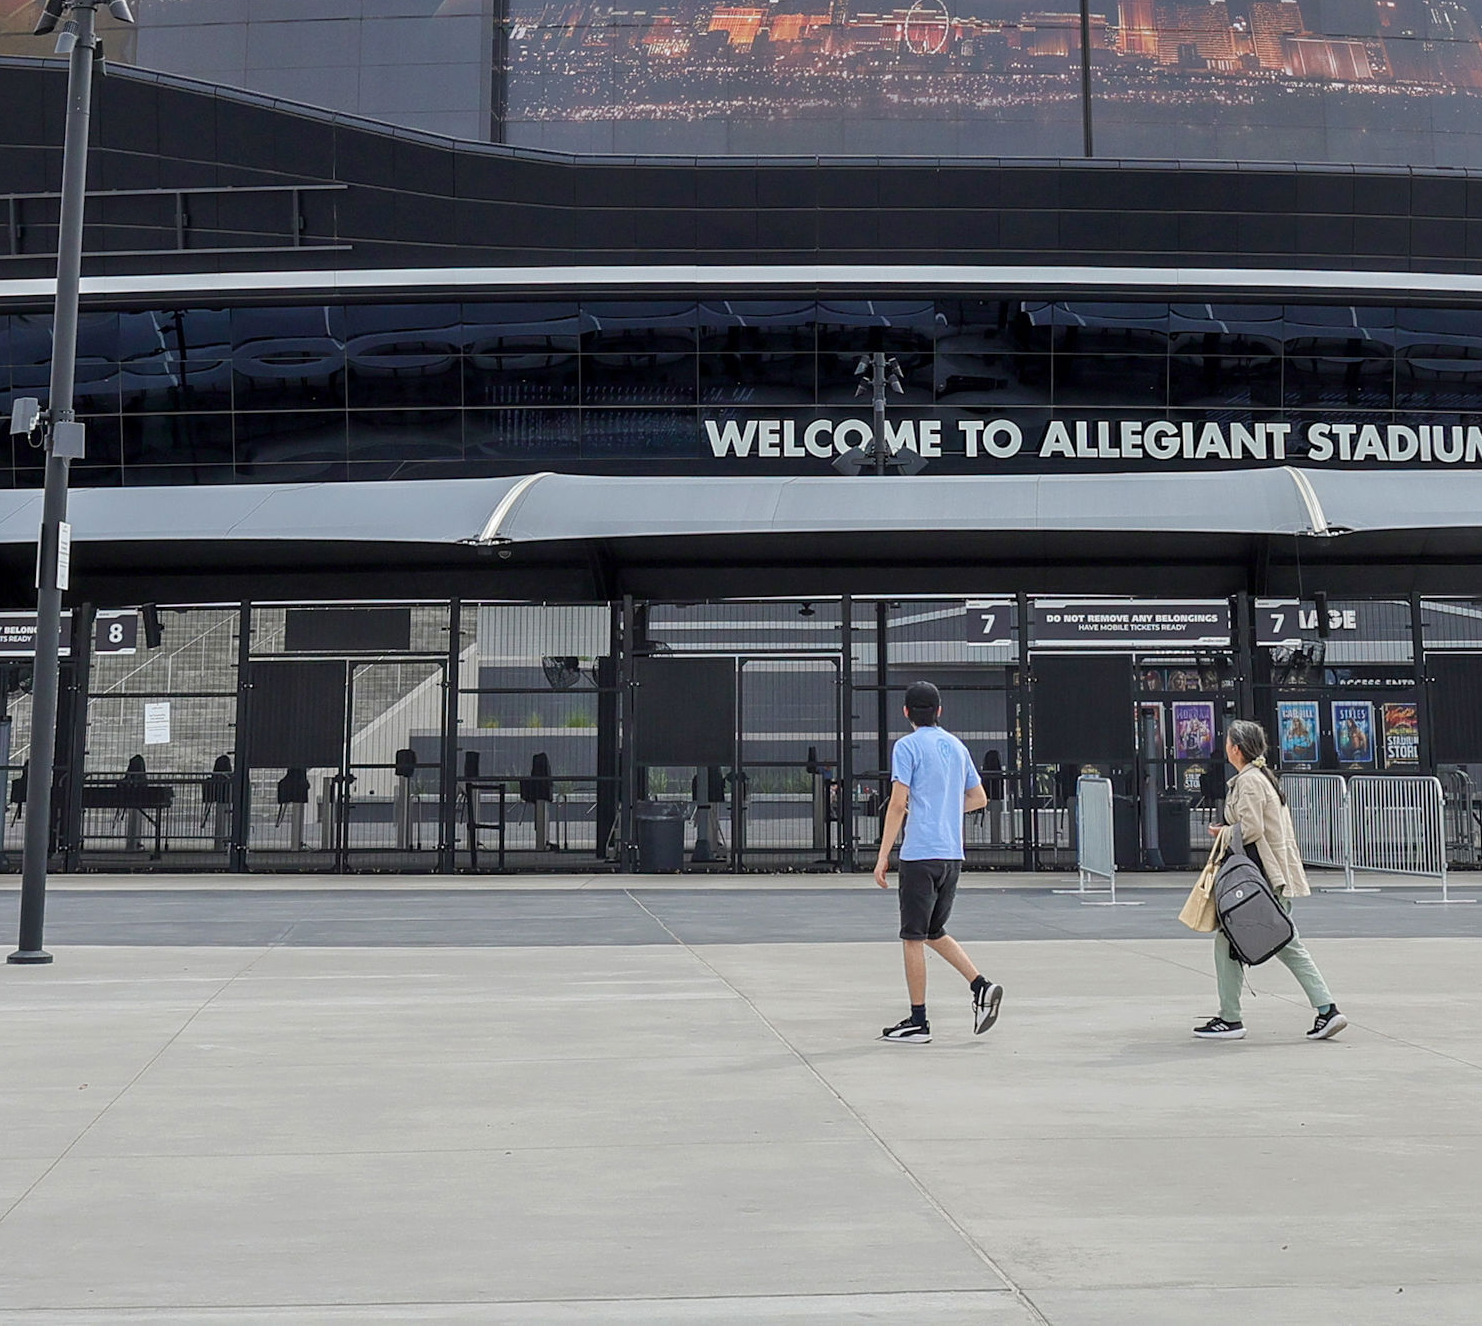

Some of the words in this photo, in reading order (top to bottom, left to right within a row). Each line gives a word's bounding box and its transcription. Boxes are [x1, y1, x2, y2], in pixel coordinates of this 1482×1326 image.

[705, 419, 941, 460] WELCOME
[958, 419, 1023, 458] TO
[1039, 421, 1292, 461] ALLEGIANT
[4, 625, 62, 634] BELON
[980, 614, 996, 634] 7
[1047, 615, 1061, 623] DO
[1064, 615, 1085, 623] NOT
[1087, 615, 1129, 623] REMOVE
[1131, 615, 1154, 623] ANY
[1155, 615, 1219, 624] BELONGINGS
[1270, 613, 1285, 634] 7
[9, 635, 32, 643] READY
[108, 623, 123, 644] 8
